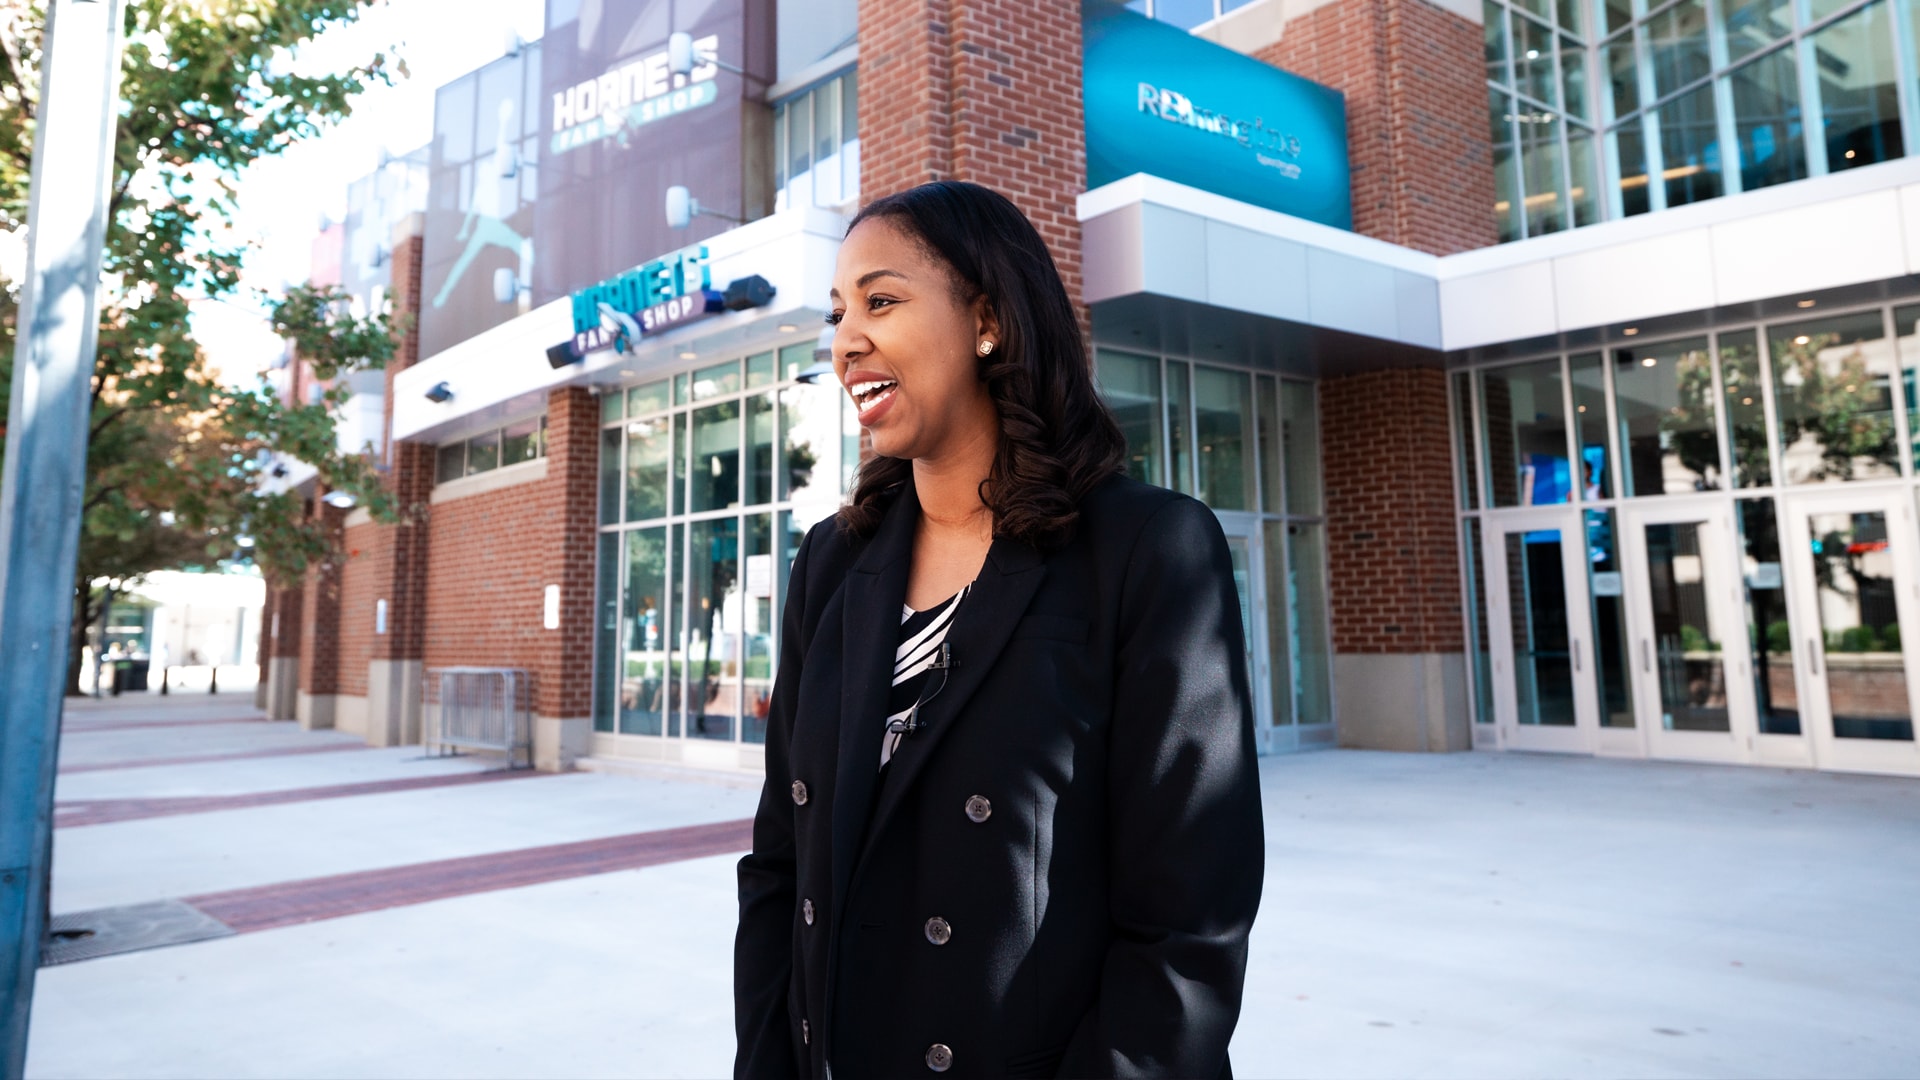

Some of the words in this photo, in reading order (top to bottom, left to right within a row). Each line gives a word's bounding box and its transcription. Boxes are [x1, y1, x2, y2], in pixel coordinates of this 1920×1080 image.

[642, 86, 705, 122] SHOP
[576, 326, 611, 352] FAN
[642, 296, 694, 330] SHOP
